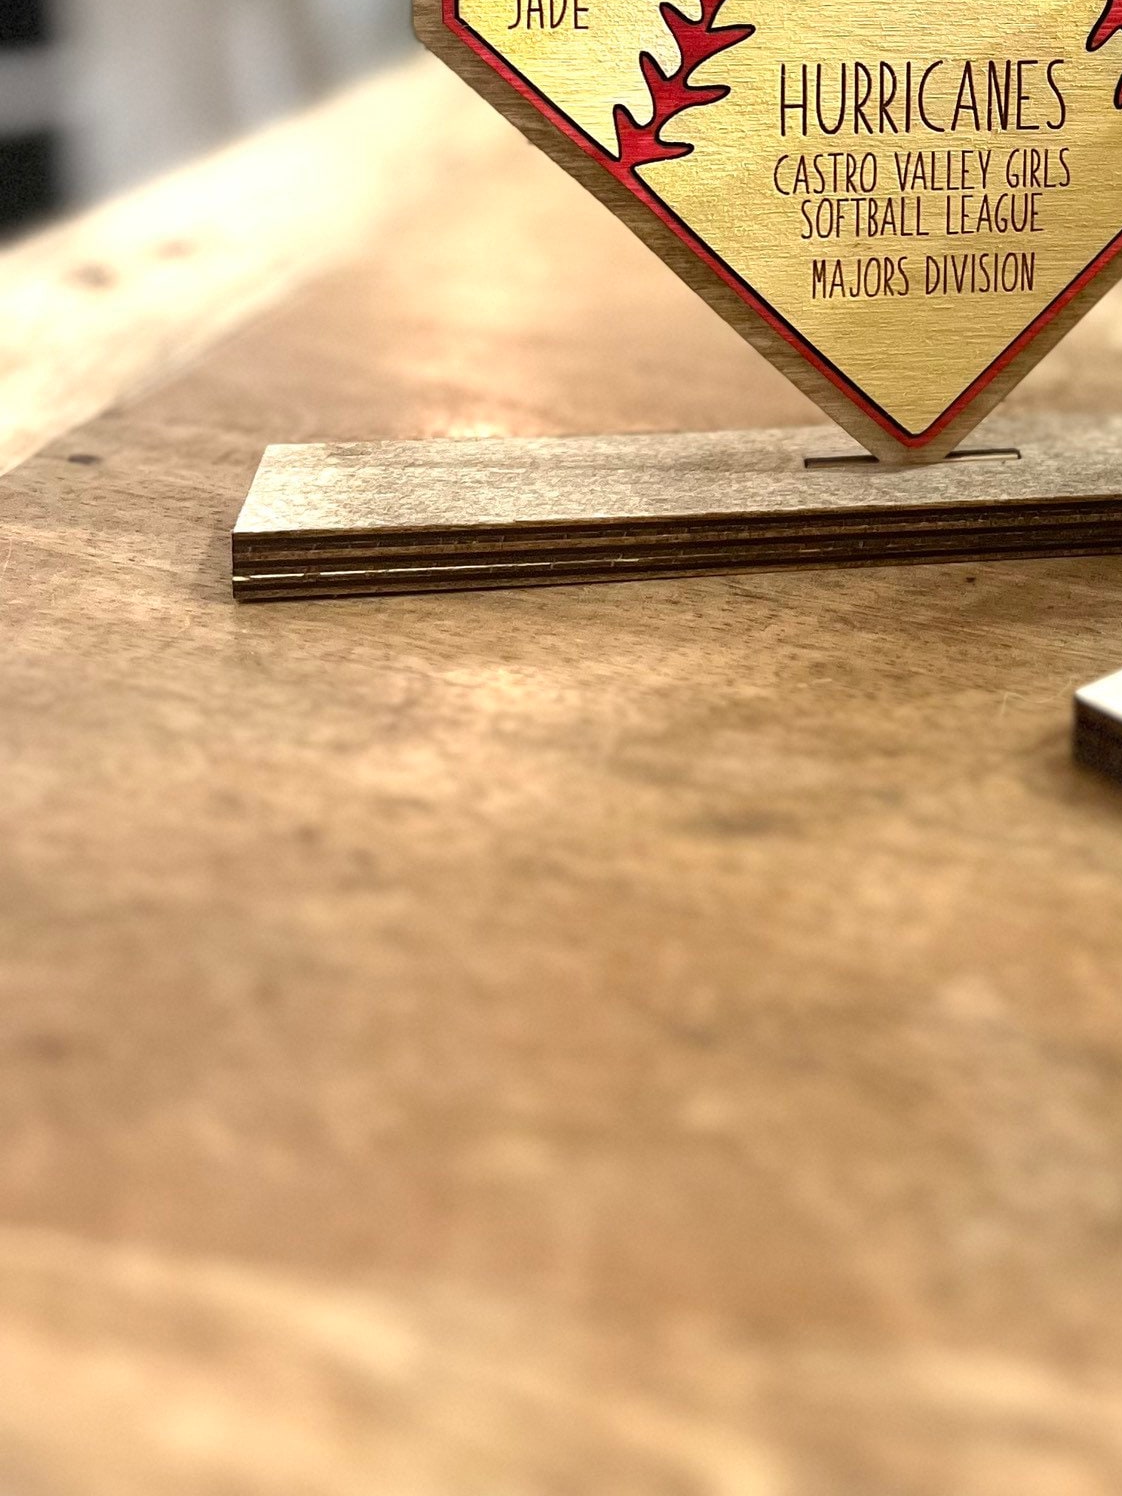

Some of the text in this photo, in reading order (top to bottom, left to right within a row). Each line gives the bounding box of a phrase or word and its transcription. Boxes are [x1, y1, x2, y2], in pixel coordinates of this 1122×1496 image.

[779, 59, 1067, 137] HURRICANES
[773, 147, 1072, 195] CASTRO VALLEY GIRLS
[800, 192, 1045, 239] SOFTBALL LEAGUE
[811, 251, 1036, 300] MAJORS DIVISION
